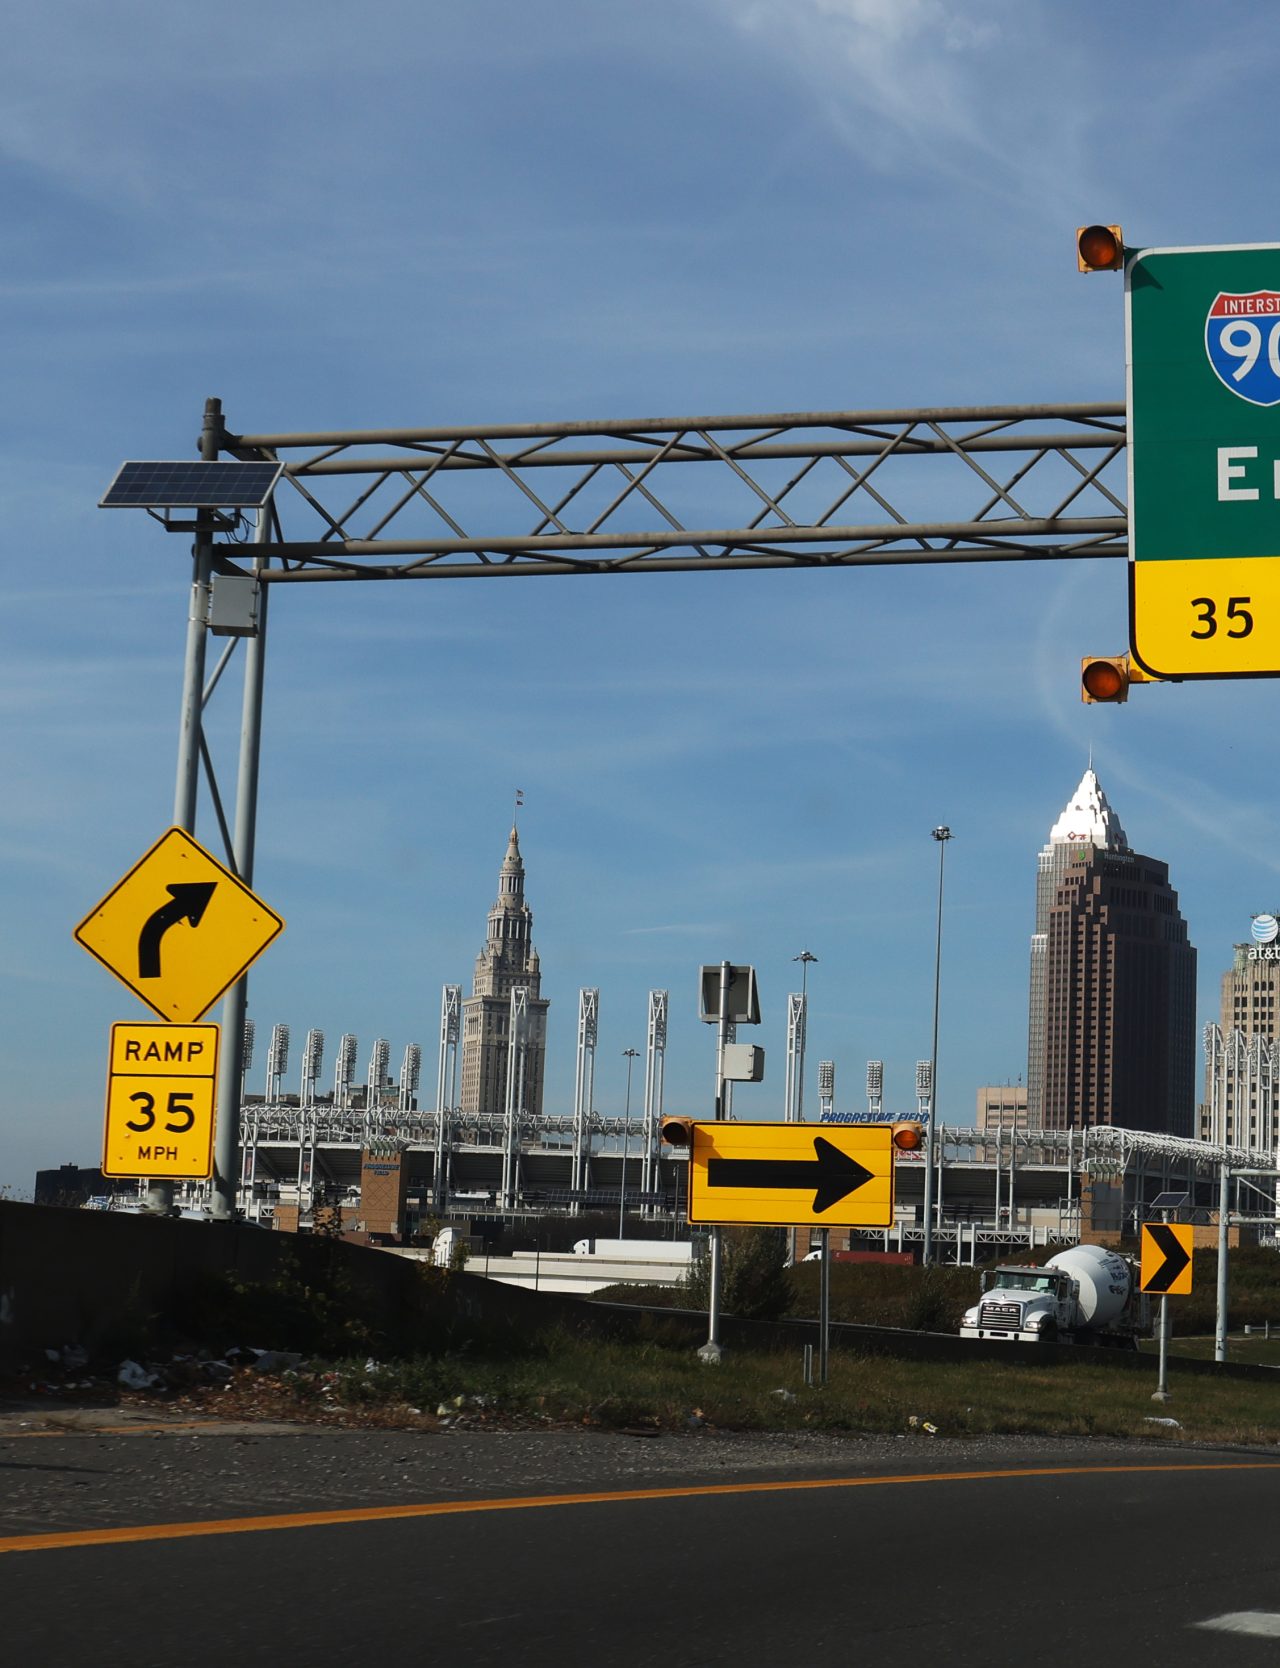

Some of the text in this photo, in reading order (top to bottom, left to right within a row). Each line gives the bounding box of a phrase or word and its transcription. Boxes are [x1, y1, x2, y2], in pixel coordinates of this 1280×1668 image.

[1190, 596, 1255, 640] 35
[1248, 944, 1280, 960] at&t
[125, 1040, 204, 1062] RAMP
[125, 1091, 195, 1134] 35
[138, 1146, 178, 1161] MPH
